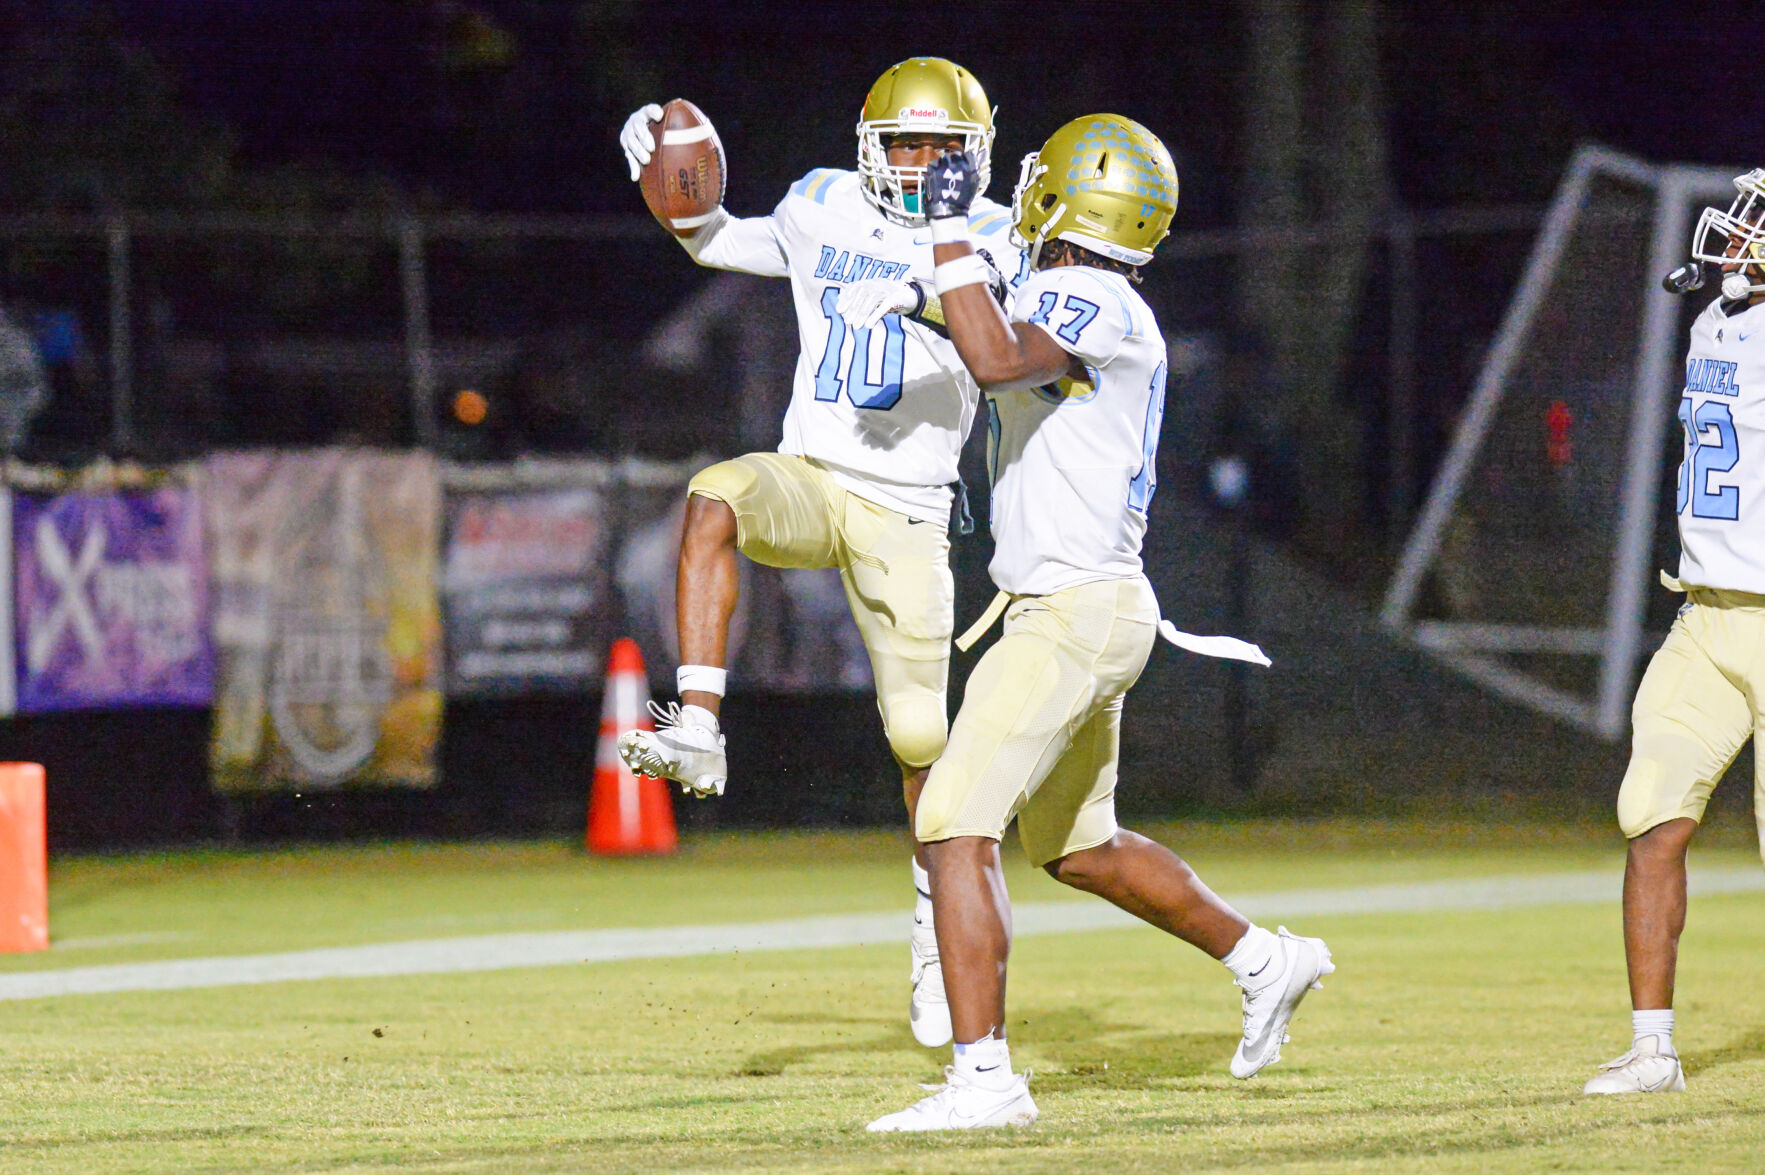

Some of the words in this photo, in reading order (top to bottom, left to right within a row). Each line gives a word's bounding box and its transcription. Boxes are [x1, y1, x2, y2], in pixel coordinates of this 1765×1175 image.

[909, 108, 937, 118] Riddell
[679, 168, 690, 199] GST
[1140, 203, 1156, 218] 17
[1028, 291, 1100, 345] 17
[814, 286, 906, 411] 10
